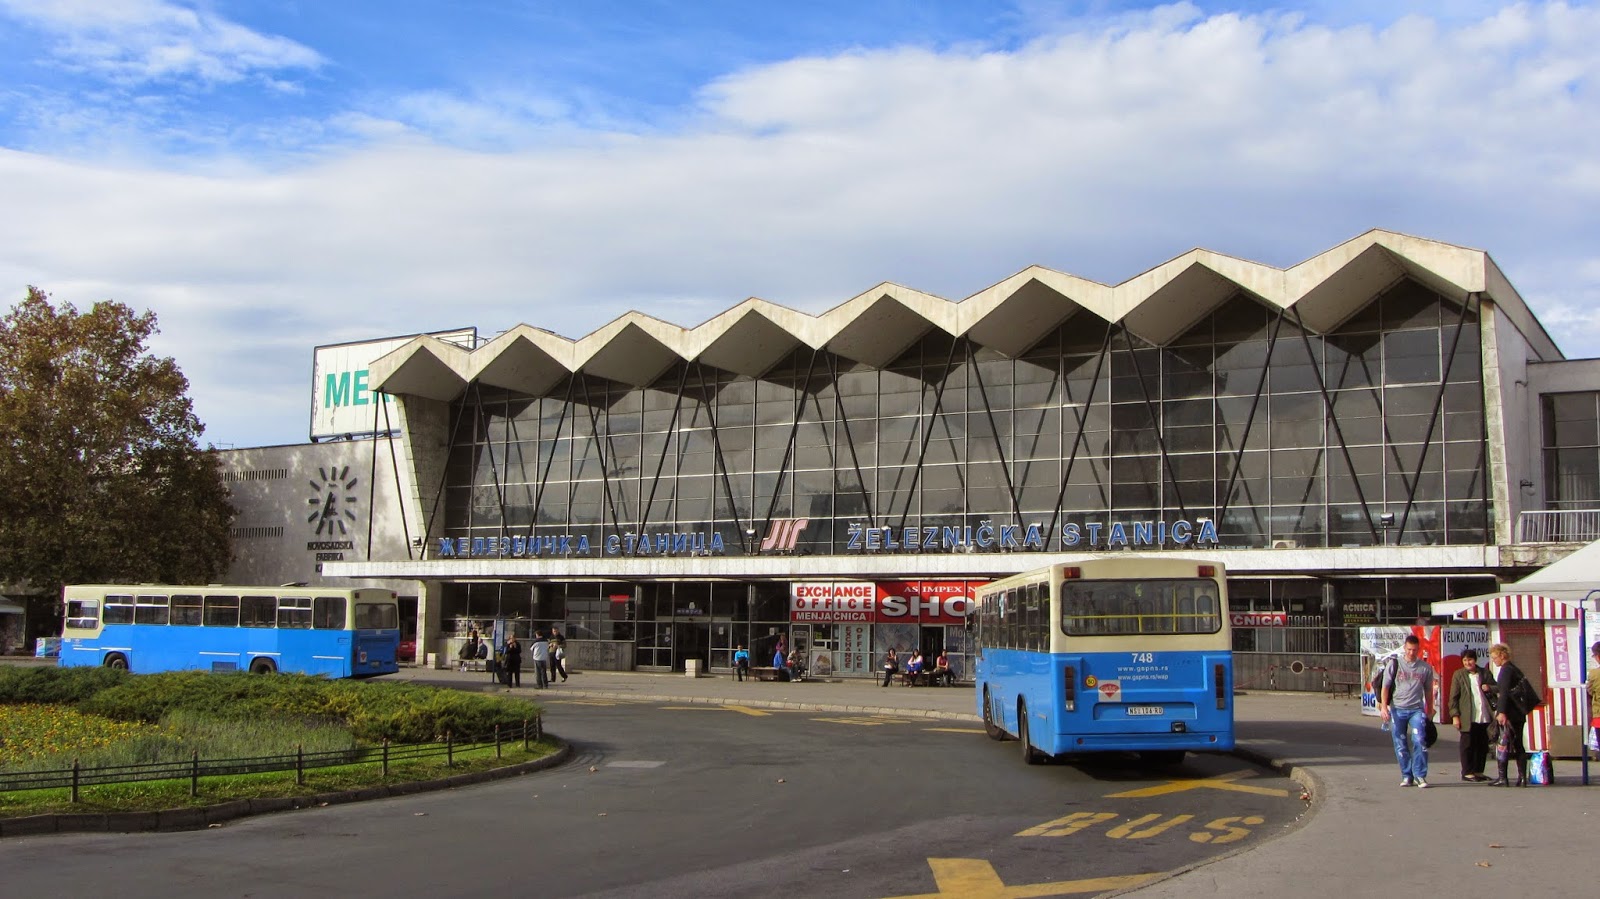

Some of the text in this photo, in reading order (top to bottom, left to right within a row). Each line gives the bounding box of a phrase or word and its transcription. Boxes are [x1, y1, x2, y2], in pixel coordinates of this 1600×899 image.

[847, 518, 1219, 549] ŽELEZNIČKA STANICA
[438, 531, 725, 556] ЖЕЛЕЗНИЧКА СТАНИЦА
[796, 586, 872, 597] EXCHANGE
[796, 598, 872, 609] OFFICE
[796, 610, 867, 621] MENJAČNICA
[1443, 631, 1465, 642] VELIKO
[1132, 653, 1153, 663] 748
[1554, 628, 1568, 679] KOKICE
[1362, 693, 1376, 707] BIG
[1013, 812, 1265, 844] BUS
